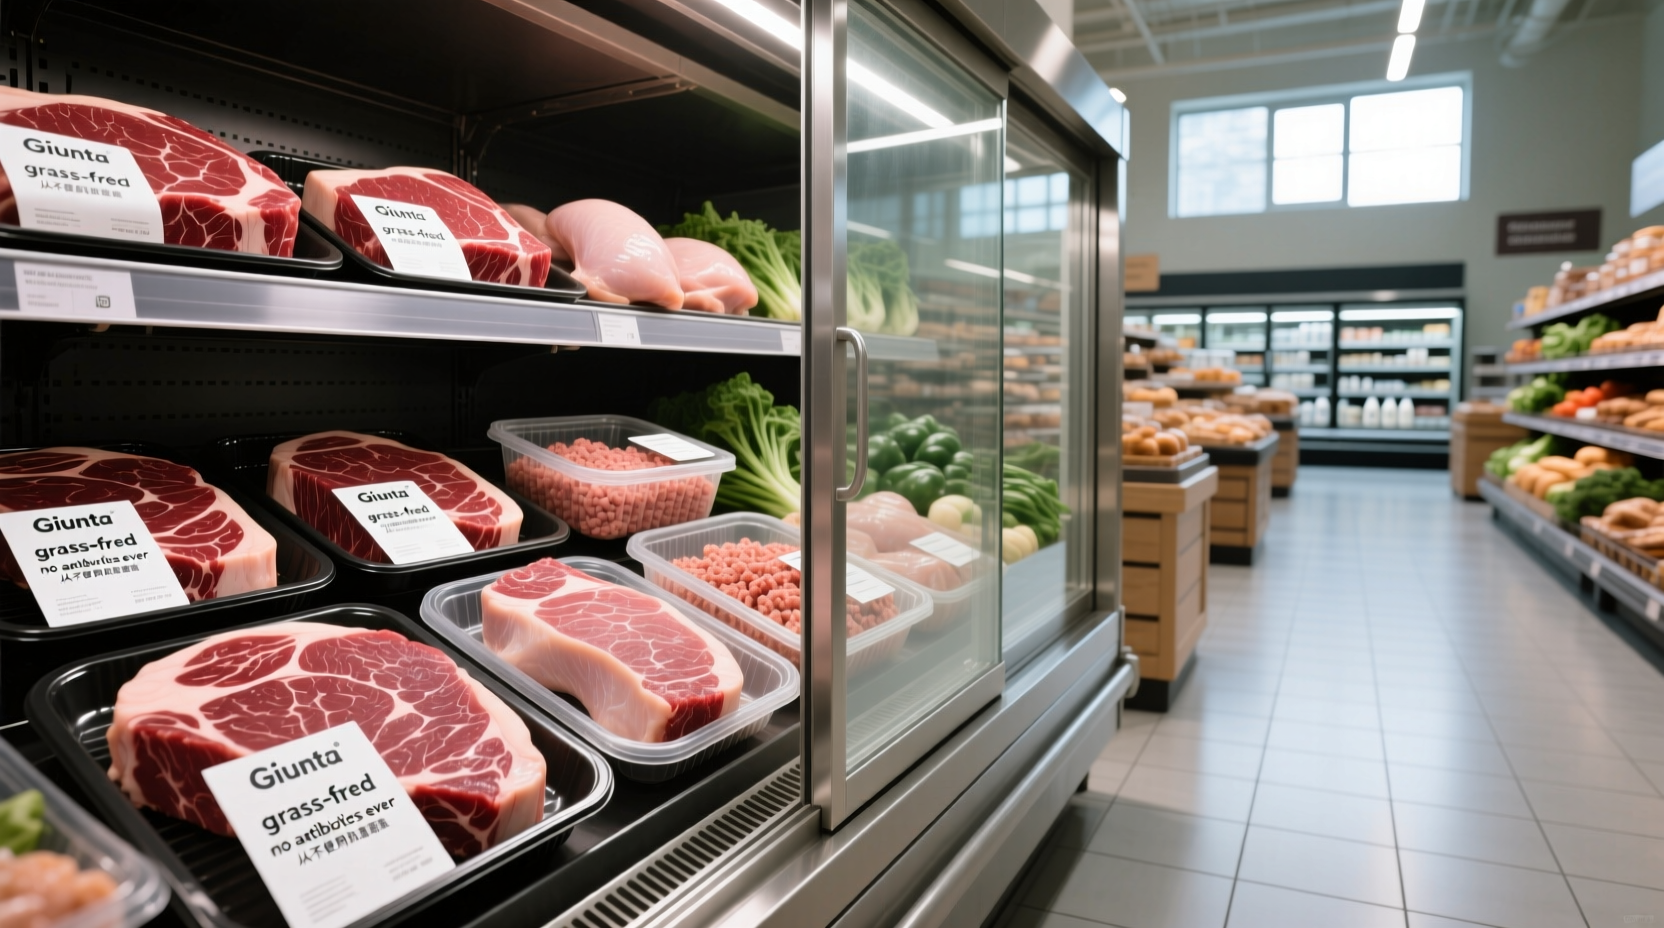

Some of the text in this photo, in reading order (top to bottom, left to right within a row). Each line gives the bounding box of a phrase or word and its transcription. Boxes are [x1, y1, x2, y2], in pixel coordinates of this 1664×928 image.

[35, 533, 138, 562] grass-fred
[40, 565, 58, 575] no
[262, 772, 377, 836] grass-fred
[270, 840, 291, 857] no
[365, 797, 396, 817] ever
